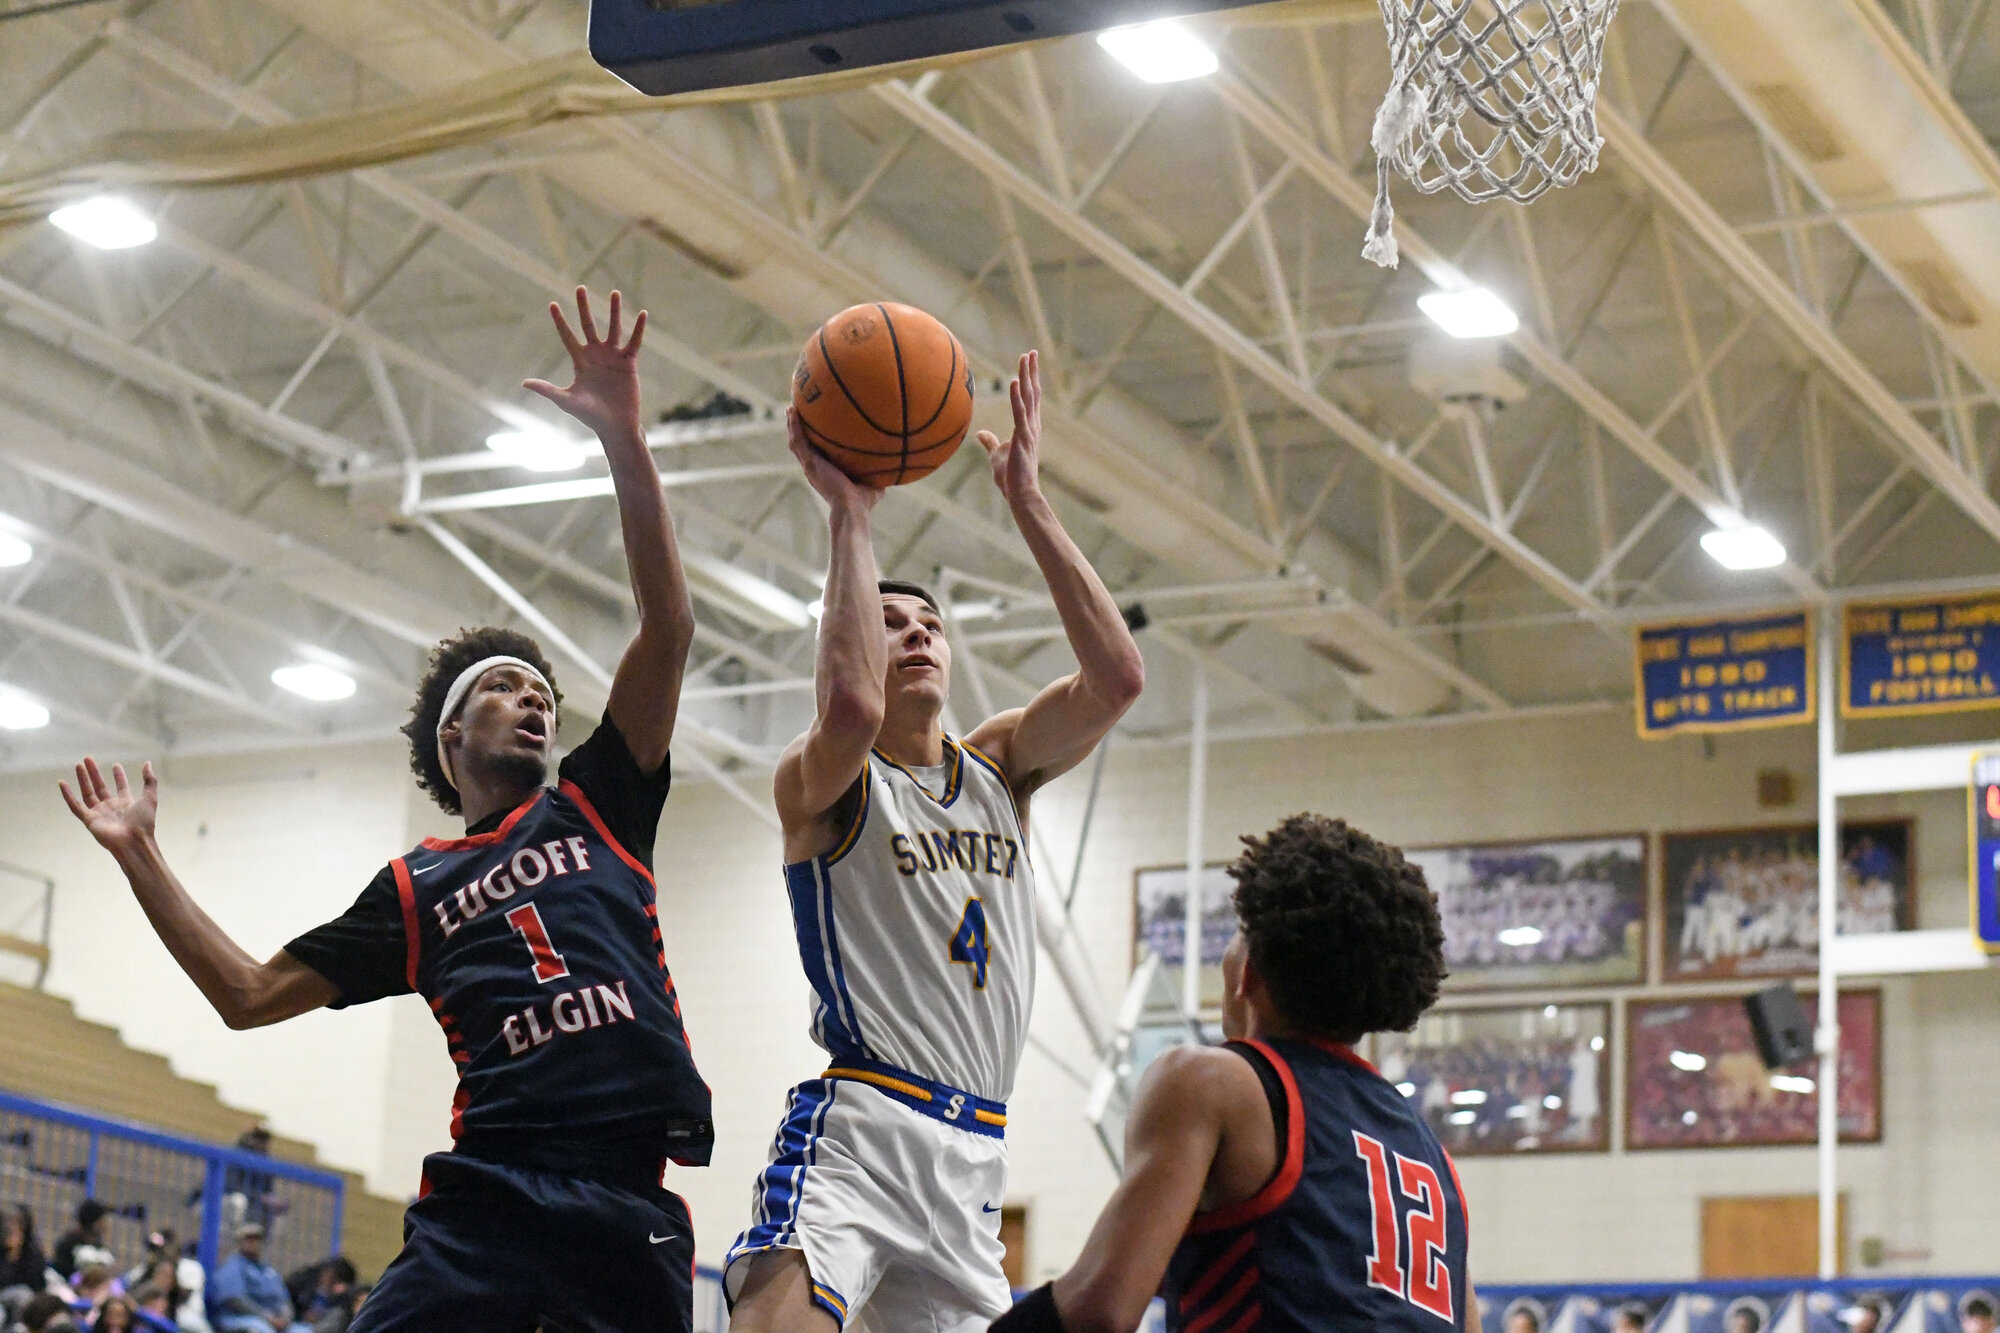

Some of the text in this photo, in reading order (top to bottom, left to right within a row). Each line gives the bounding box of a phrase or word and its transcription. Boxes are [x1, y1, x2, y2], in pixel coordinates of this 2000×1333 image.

[433, 836, 592, 938] LUGOFF
[504, 900, 571, 985] 1
[948, 896, 991, 991] 4
[502, 980, 636, 1057] ELGIN
[943, 1094, 966, 1120] S
[1351, 1129, 1454, 1325] 12
